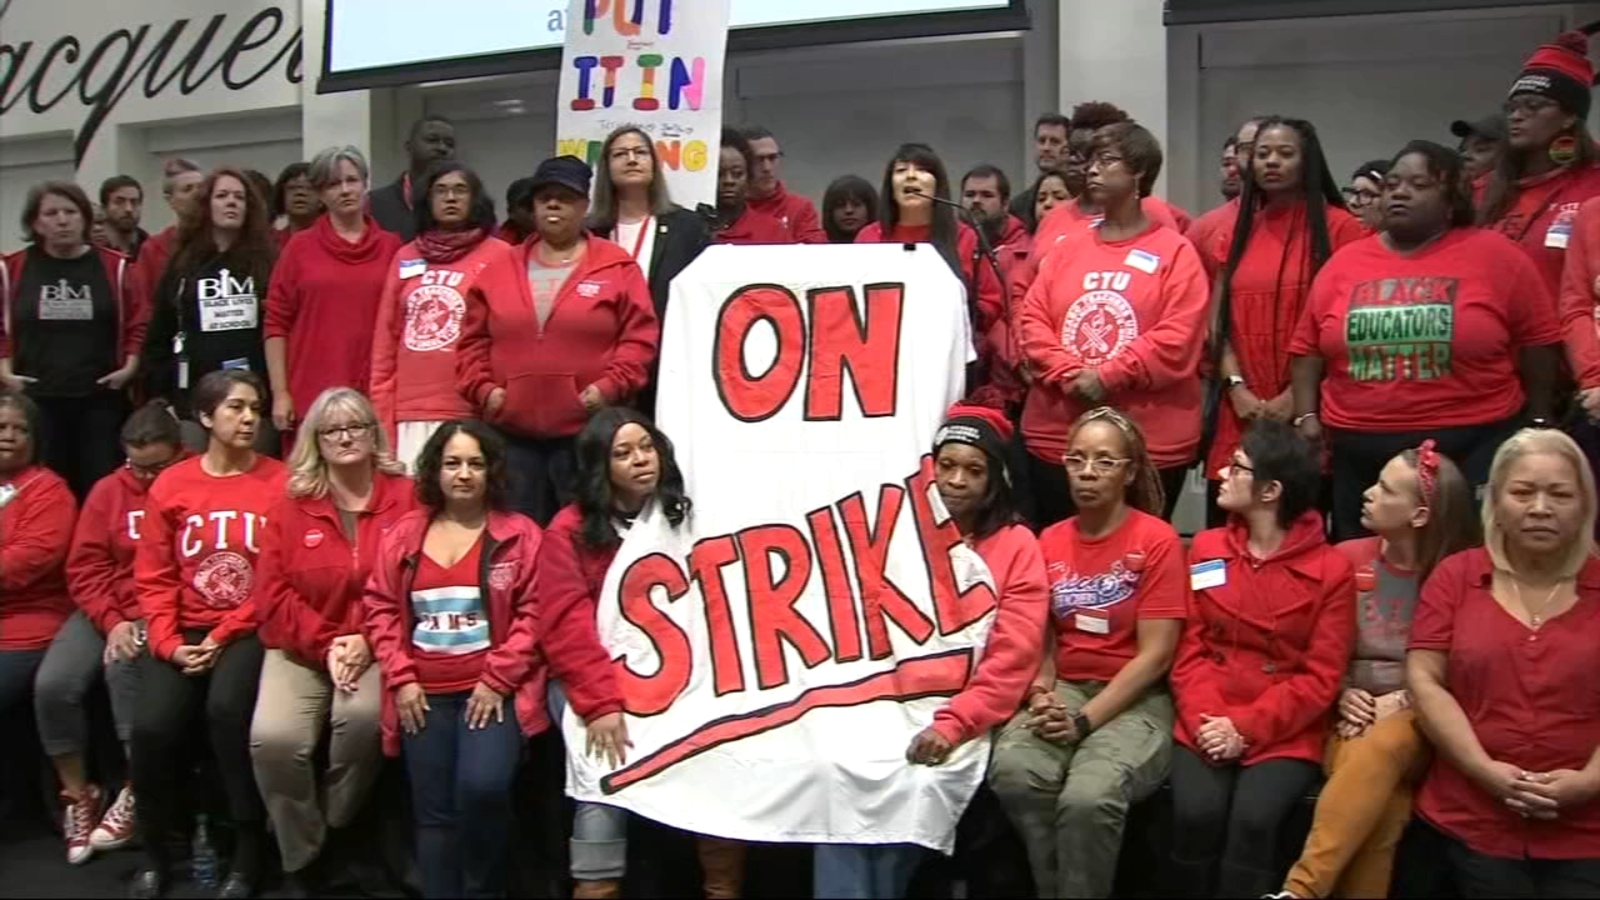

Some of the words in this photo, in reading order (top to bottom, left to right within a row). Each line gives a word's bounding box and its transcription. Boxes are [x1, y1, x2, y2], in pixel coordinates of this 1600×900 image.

[547, 9, 569, 31] a
[0, 6, 303, 169] acque
[571, 55, 624, 111] IT
[633, 54, 705, 111] IN
[421, 269, 465, 287] CTU
[1083, 271, 1131, 290] CTU
[1350, 279, 1456, 306] BLACK
[1347, 307, 1451, 341] EDUCATORS
[713, 282, 905, 423] ON
[1348, 343, 1452, 380] MATTER
[181, 510, 268, 558] CTU
[611, 453, 997, 717] STRIKE
